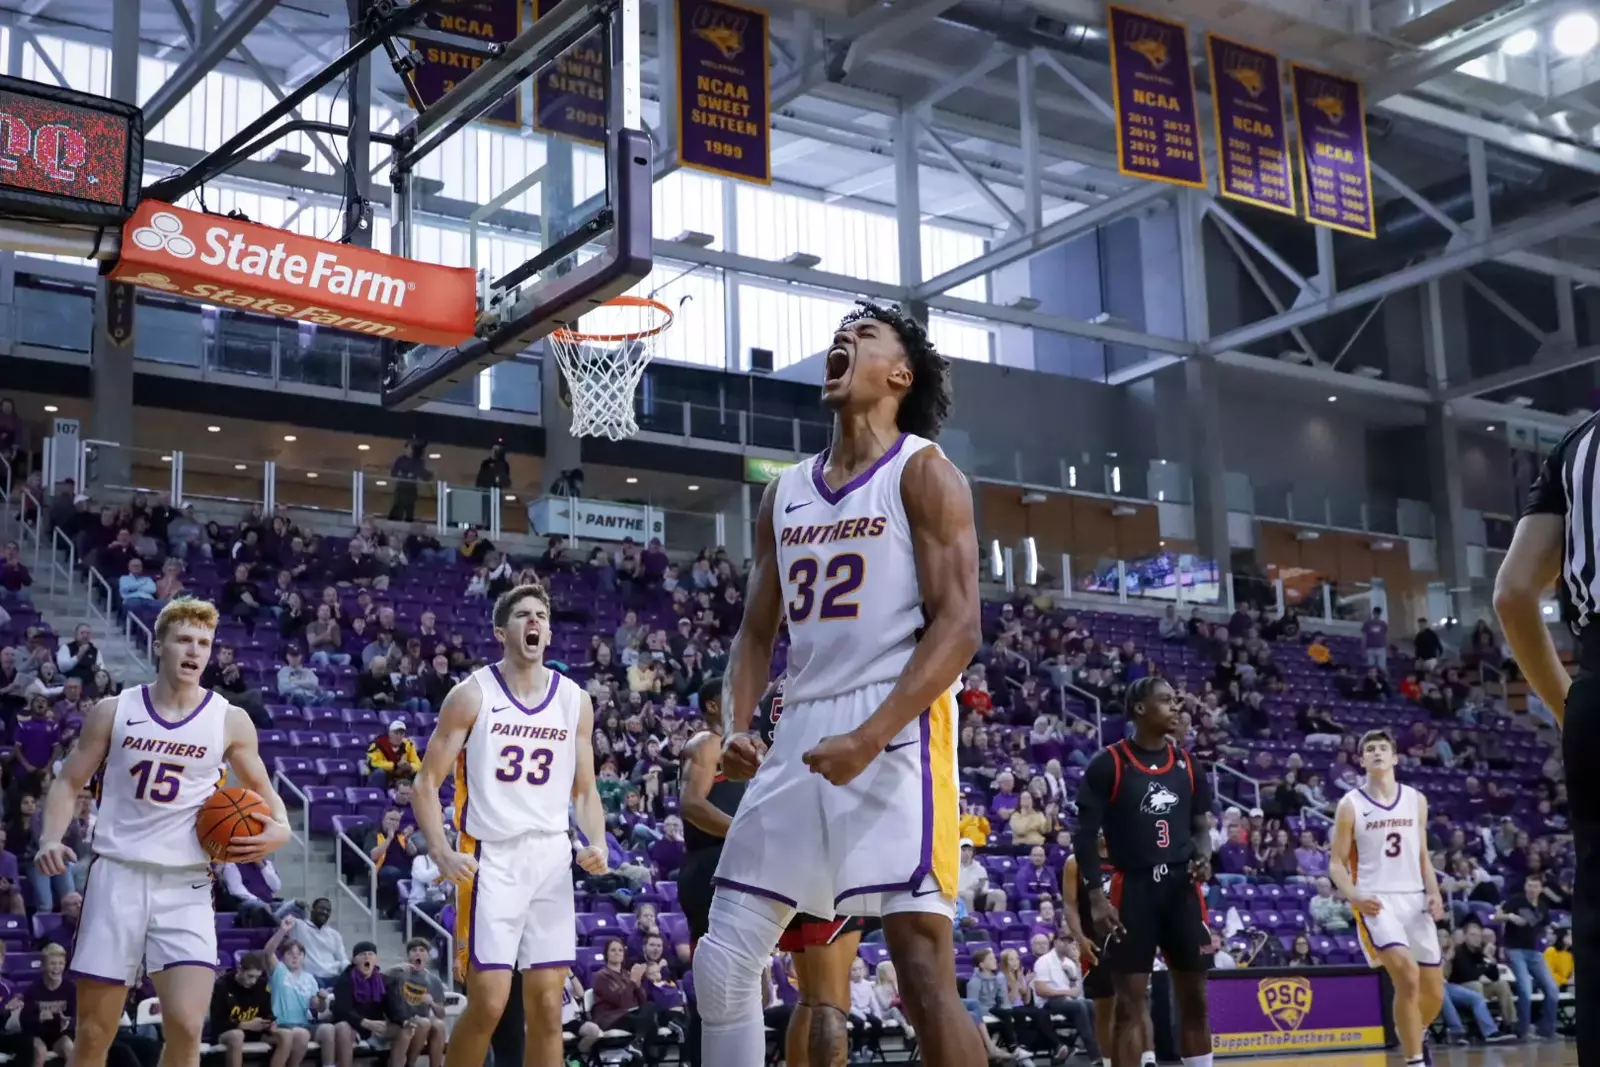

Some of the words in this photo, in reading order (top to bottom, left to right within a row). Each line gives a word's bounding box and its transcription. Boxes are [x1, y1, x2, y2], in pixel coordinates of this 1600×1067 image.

[440, 15, 495, 37] NCAA
[427, 47, 483, 70] SIXTE
[555, 59, 604, 83] SWEE
[697, 75, 750, 101] NCAA
[1133, 88, 1180, 112] NCAA
[697, 93, 751, 117] SWEET
[691, 109, 758, 137] SIXTEEN
[1232, 114, 1275, 138] NCAA
[704, 139, 743, 160] 1999
[1316, 142, 1354, 165] NCAA
[56, 422, 77, 434] 107
[585, 513, 662, 533] PANTHES
[781, 516, 888, 547] PANTHERS
[788, 552, 866, 624] 32
[490, 722, 568, 742] PANTHERS
[122, 735, 207, 760] PANTHERS
[495, 744, 554, 786] 33
[129, 759, 185, 803] 15
[1155, 819, 1170, 848] 3
[1366, 818, 1414, 832] PANTHERS
[1385, 832, 1402, 858] 3
[1264, 984, 1307, 1009] PSC
[1212, 1032, 1363, 1052] SupportThePanthers.com
